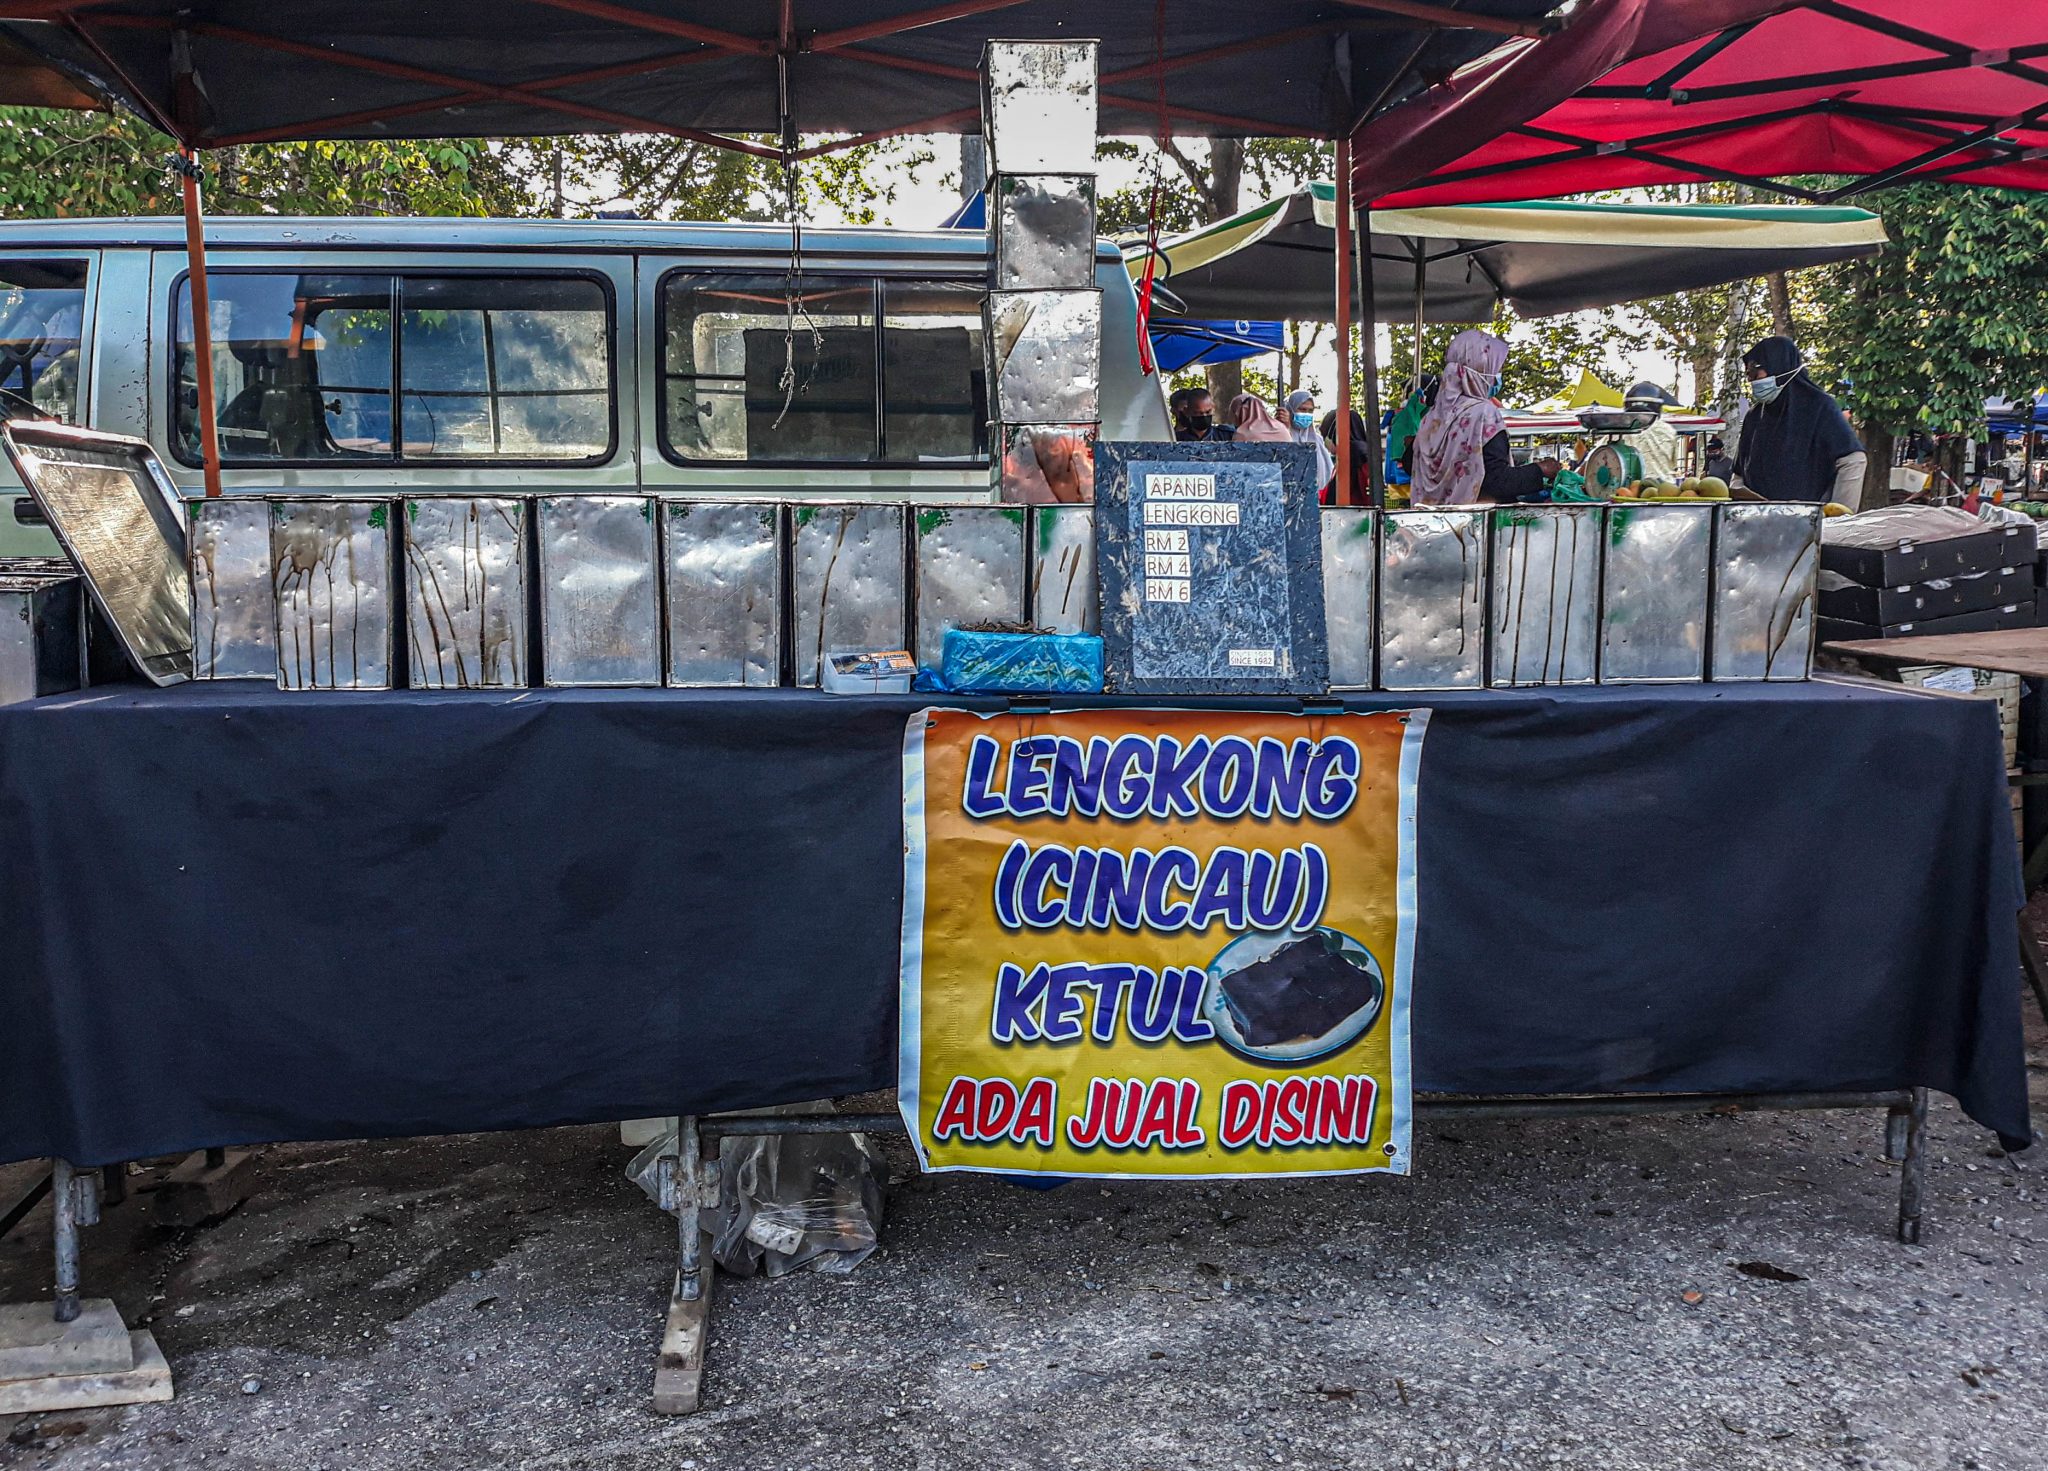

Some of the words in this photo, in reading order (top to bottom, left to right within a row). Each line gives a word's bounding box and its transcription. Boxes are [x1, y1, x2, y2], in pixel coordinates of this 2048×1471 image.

[1149, 478, 1214, 497] APANDI
[1144, 504, 1238, 524] LENGKONG
[1146, 532, 1172, 551] RM
[1178, 532, 1187, 551] 2
[1147, 556, 1173, 575] RM
[1178, 556, 1189, 575] 4
[1147, 582, 1173, 601] RM
[1178, 582, 1189, 601] 6
[1230, 653, 1252, 665] SINCE
[1254, 653, 1273, 665] 1982
[962, 734, 1361, 819] LENGKONG
[994, 840, 1328, 932] (CINCAU)
[991, 962, 1215, 1042] KETUL
[933, 1075, 1058, 1147] ADA
[1067, 1076, 1204, 1149] JUAL
[1218, 1075, 1378, 1149] DISINI
